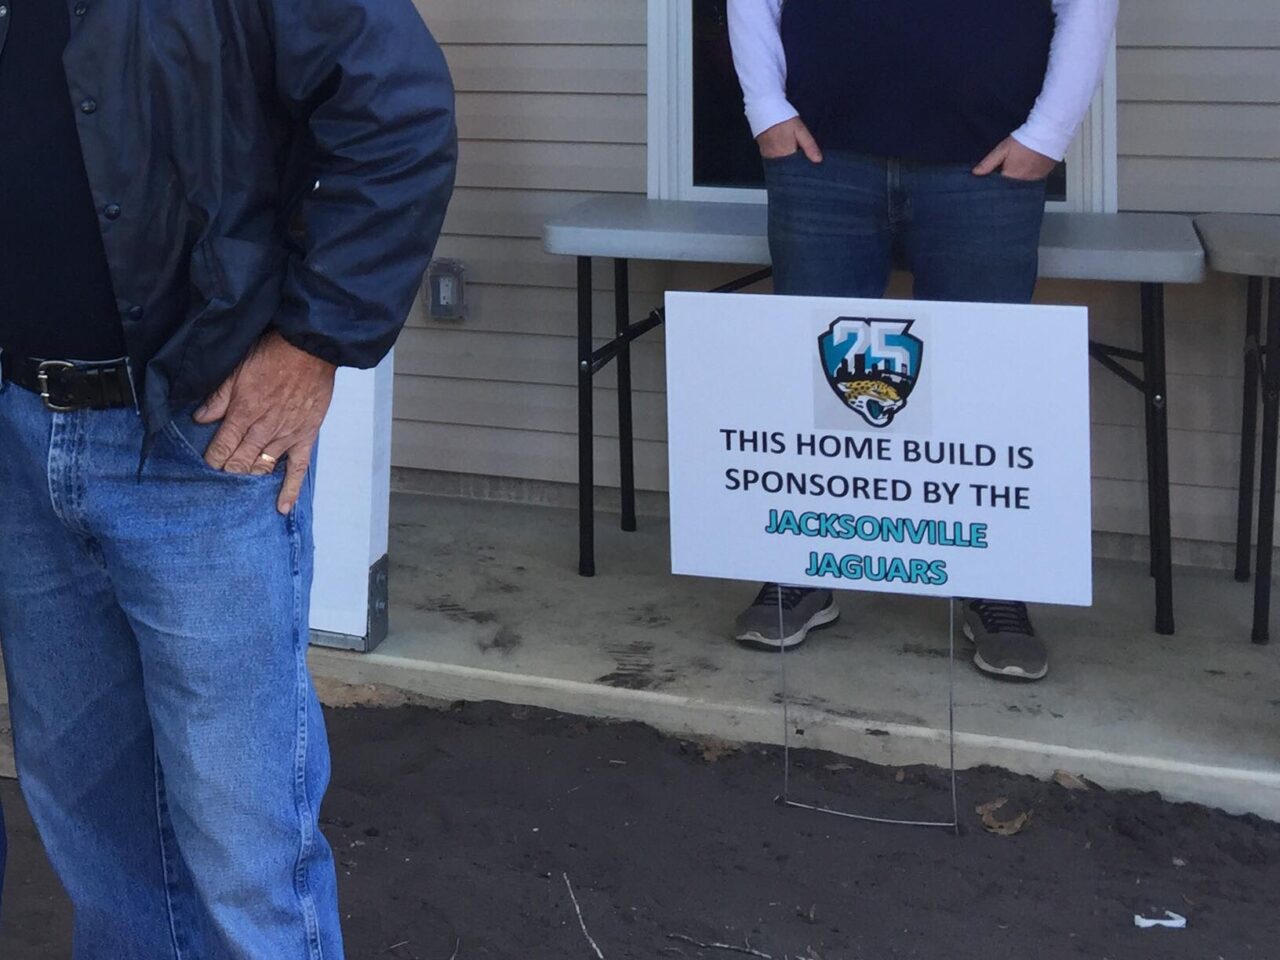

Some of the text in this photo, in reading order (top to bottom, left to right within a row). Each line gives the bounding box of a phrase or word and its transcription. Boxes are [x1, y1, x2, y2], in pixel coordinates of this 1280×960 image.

[720, 428, 1034, 469] THIS HOME BUILD IS
[725, 468, 1030, 509] SPONSORED BY THE
[765, 509, 988, 548] JACKSONVILLE
[805, 552, 948, 585] JAGUARS
